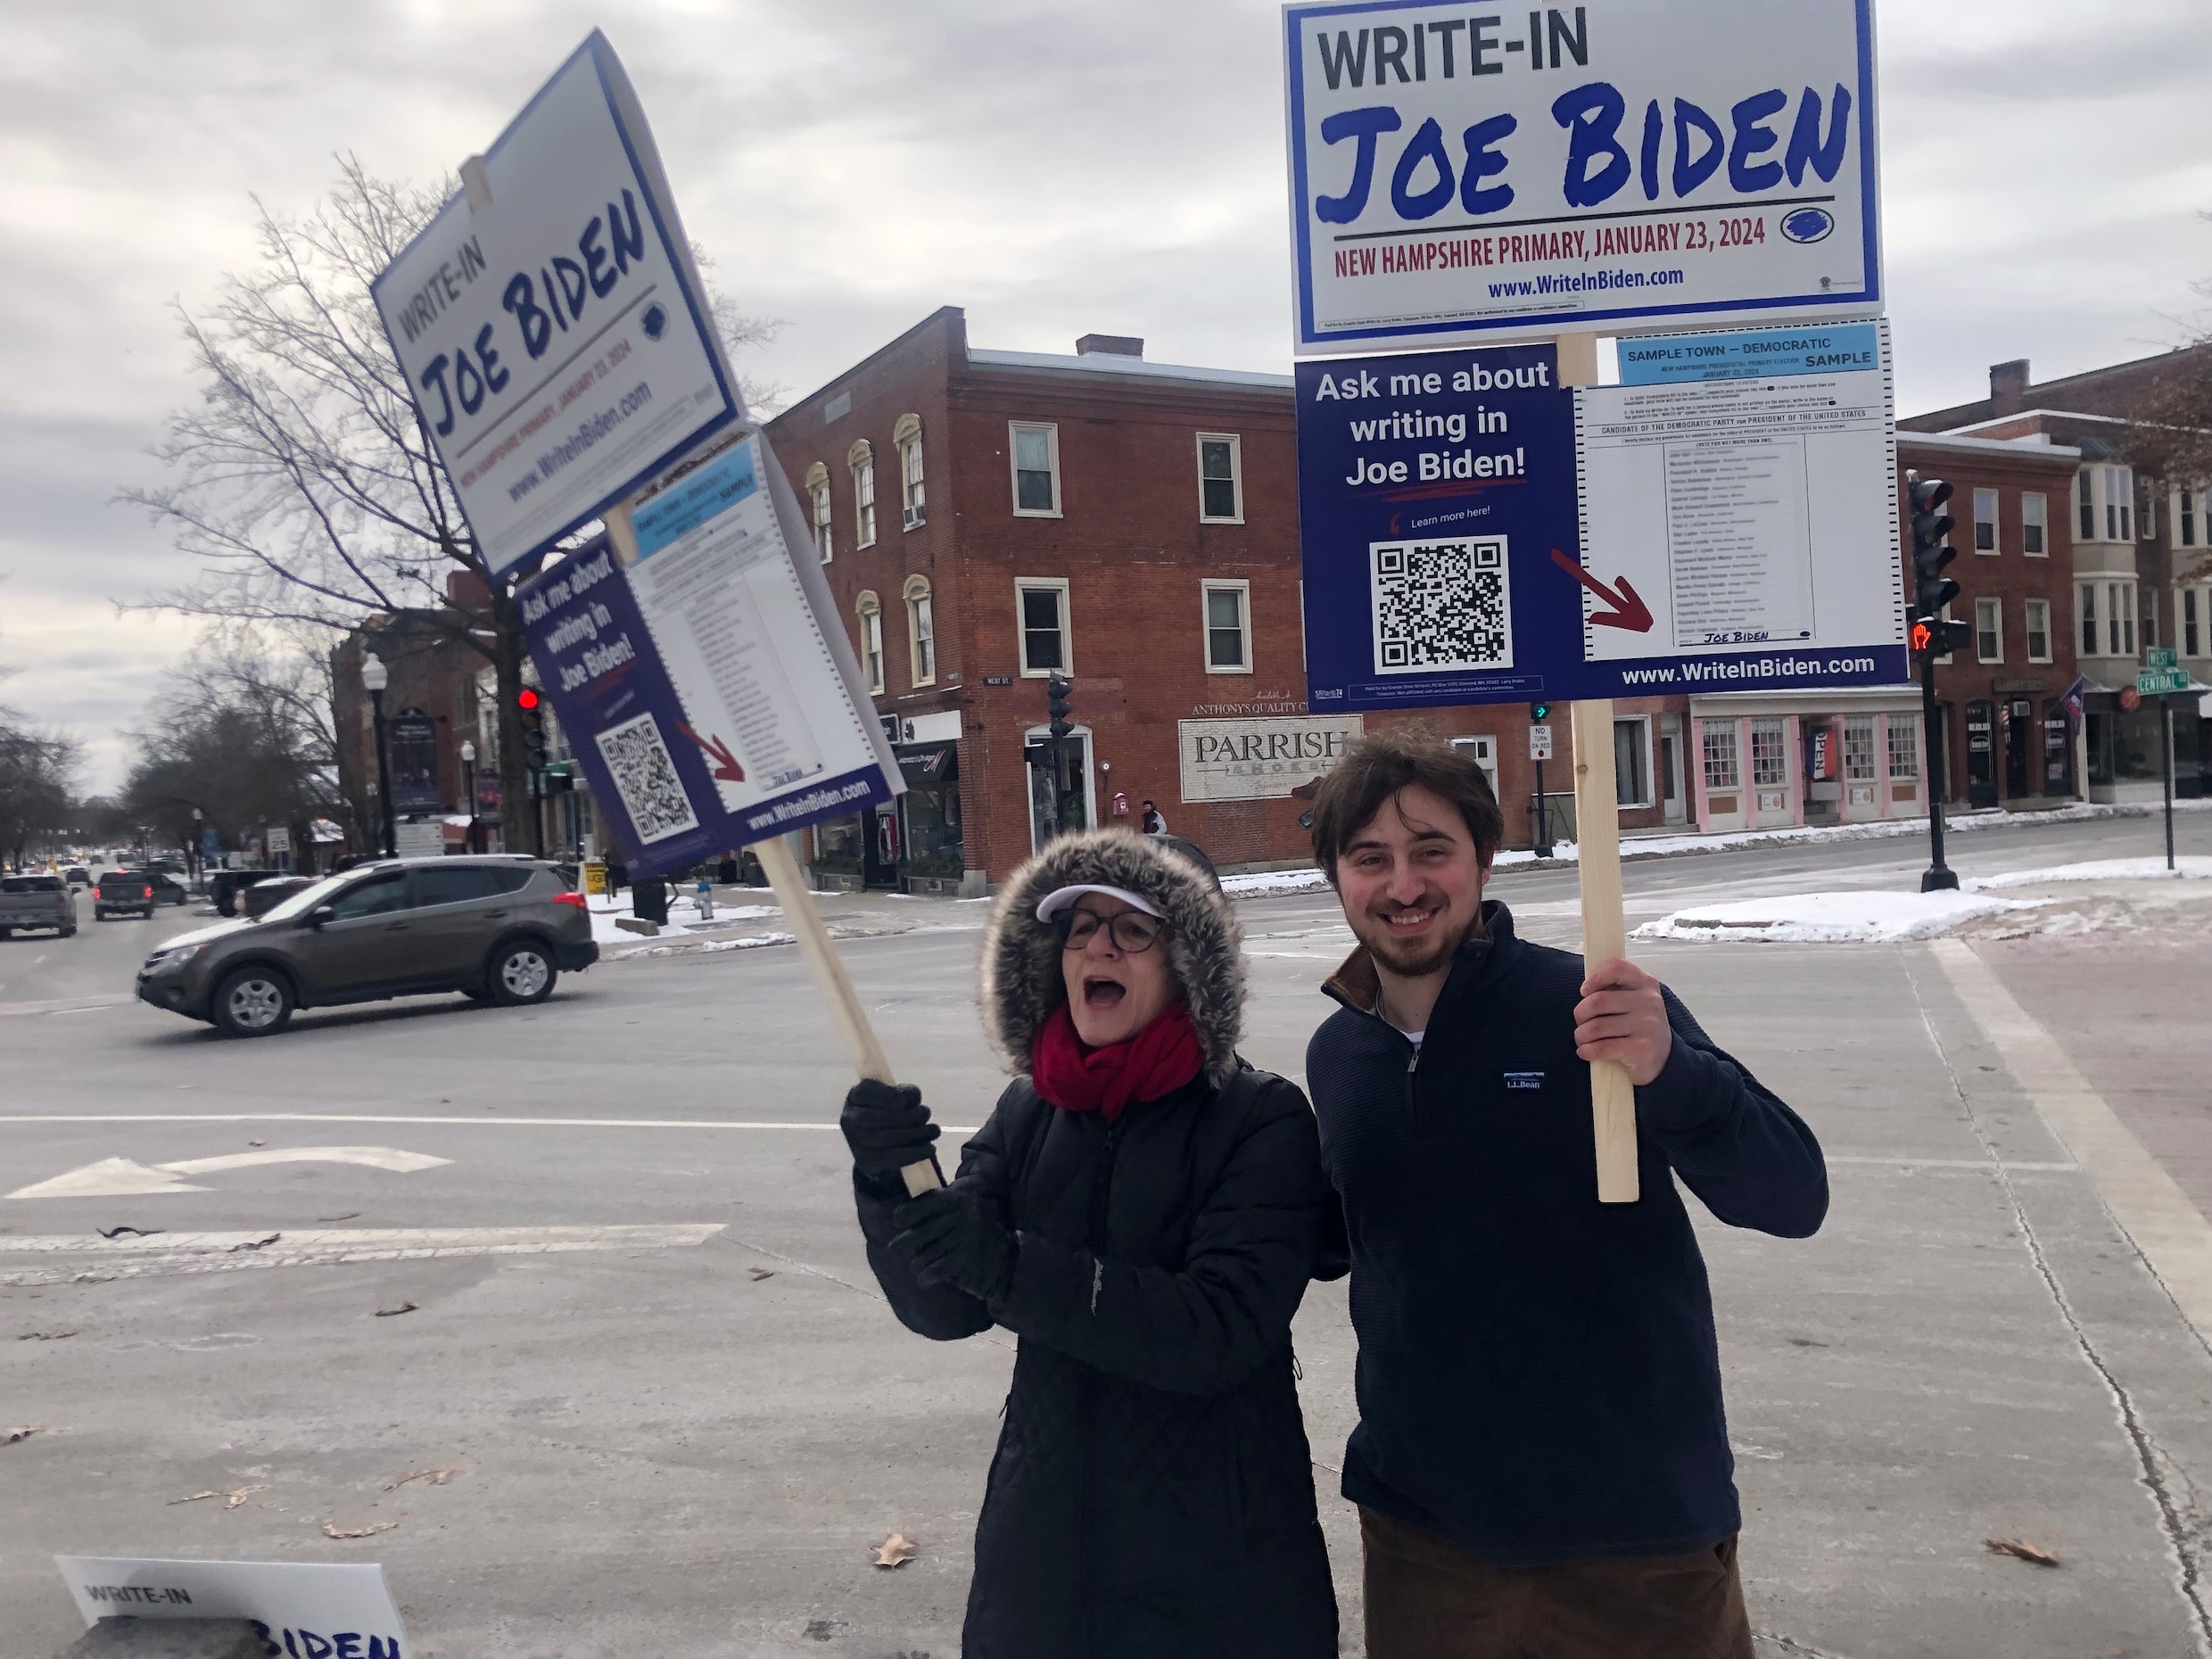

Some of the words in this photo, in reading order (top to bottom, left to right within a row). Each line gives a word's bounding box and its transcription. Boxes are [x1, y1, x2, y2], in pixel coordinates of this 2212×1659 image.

[1318, 7, 1589, 90] WRITE-IN
[1316, 106, 1517, 224] JOE
[1551, 81, 1852, 208] BIDEN
[1335, 246, 1376, 278] NEW
[1382, 237, 1495, 275] HAMPSHIRE
[1498, 233, 1590, 268] PRIMARY,
[1595, 223, 1681, 258] JANUARY
[1685, 220, 1714, 254] 23,
[1719, 217, 1766, 250] 2024
[399, 235, 487, 344] WRITE-IN
[1488, 267, 1684, 299] www.WriteInBiden.com
[421, 324, 512, 437] JOE
[503, 188, 645, 360] BIDEN
[1628, 349, 1682, 362] SAMPLE
[1686, 345, 1725, 358] TOWN
[1743, 338, 1831, 354] DEMOCRATIC
[1805, 351, 1871, 367] SAMPLE
[1315, 370, 1381, 401] Ask
[1389, 371, 1442, 397] me
[1452, 361, 1550, 392] about
[1349, 409, 1467, 443] writing
[1477, 405, 1507, 434] in
[1602, 425, 1638, 434] CANDIDATE
[1652, 423, 1664, 431] THE
[1667, 420, 1711, 430] DEMOCRATIC
[1747, 415, 1785, 424] PRESIDENT
[1814, 411, 1839, 419] UNITED
[508, 381, 653, 504] www.WriteInBiden.com
[1345, 456, 1408, 487] Joe
[1418, 447, 1525, 482] Biden!
[1411, 514, 1437, 529] Learn
[1440, 510, 1465, 524] more
[1466, 505, 1491, 520] here!
[546, 581, 572, 609] me
[569, 549, 614, 595] about
[545, 613, 598, 654] writing
[588, 601, 613, 628] in
[1704, 632, 1729, 643] JOE
[1733, 631, 1769, 642] BIDEN
[558, 663, 589, 692] Joe
[581, 631, 636, 678] Biden!
[1622, 656, 1875, 686] www.WriteInBiden.com
[2150, 651, 2167, 666] WEST
[2139, 673, 2176, 692] CENTRAL
[1192, 703, 1250, 715] ANTHONY'S
[1251, 701, 1298, 714] QUALITY
[1194, 731, 1349, 763] PARRISH
[1815, 732, 1827, 770] OPEN
[747, 780, 871, 830] www.WriteInBiden.com
[271, 840, 288, 850] 25
[1507, 1081, 1540, 1089] L.L.Bean
[84, 1585, 193, 1605] WRITE-IN
